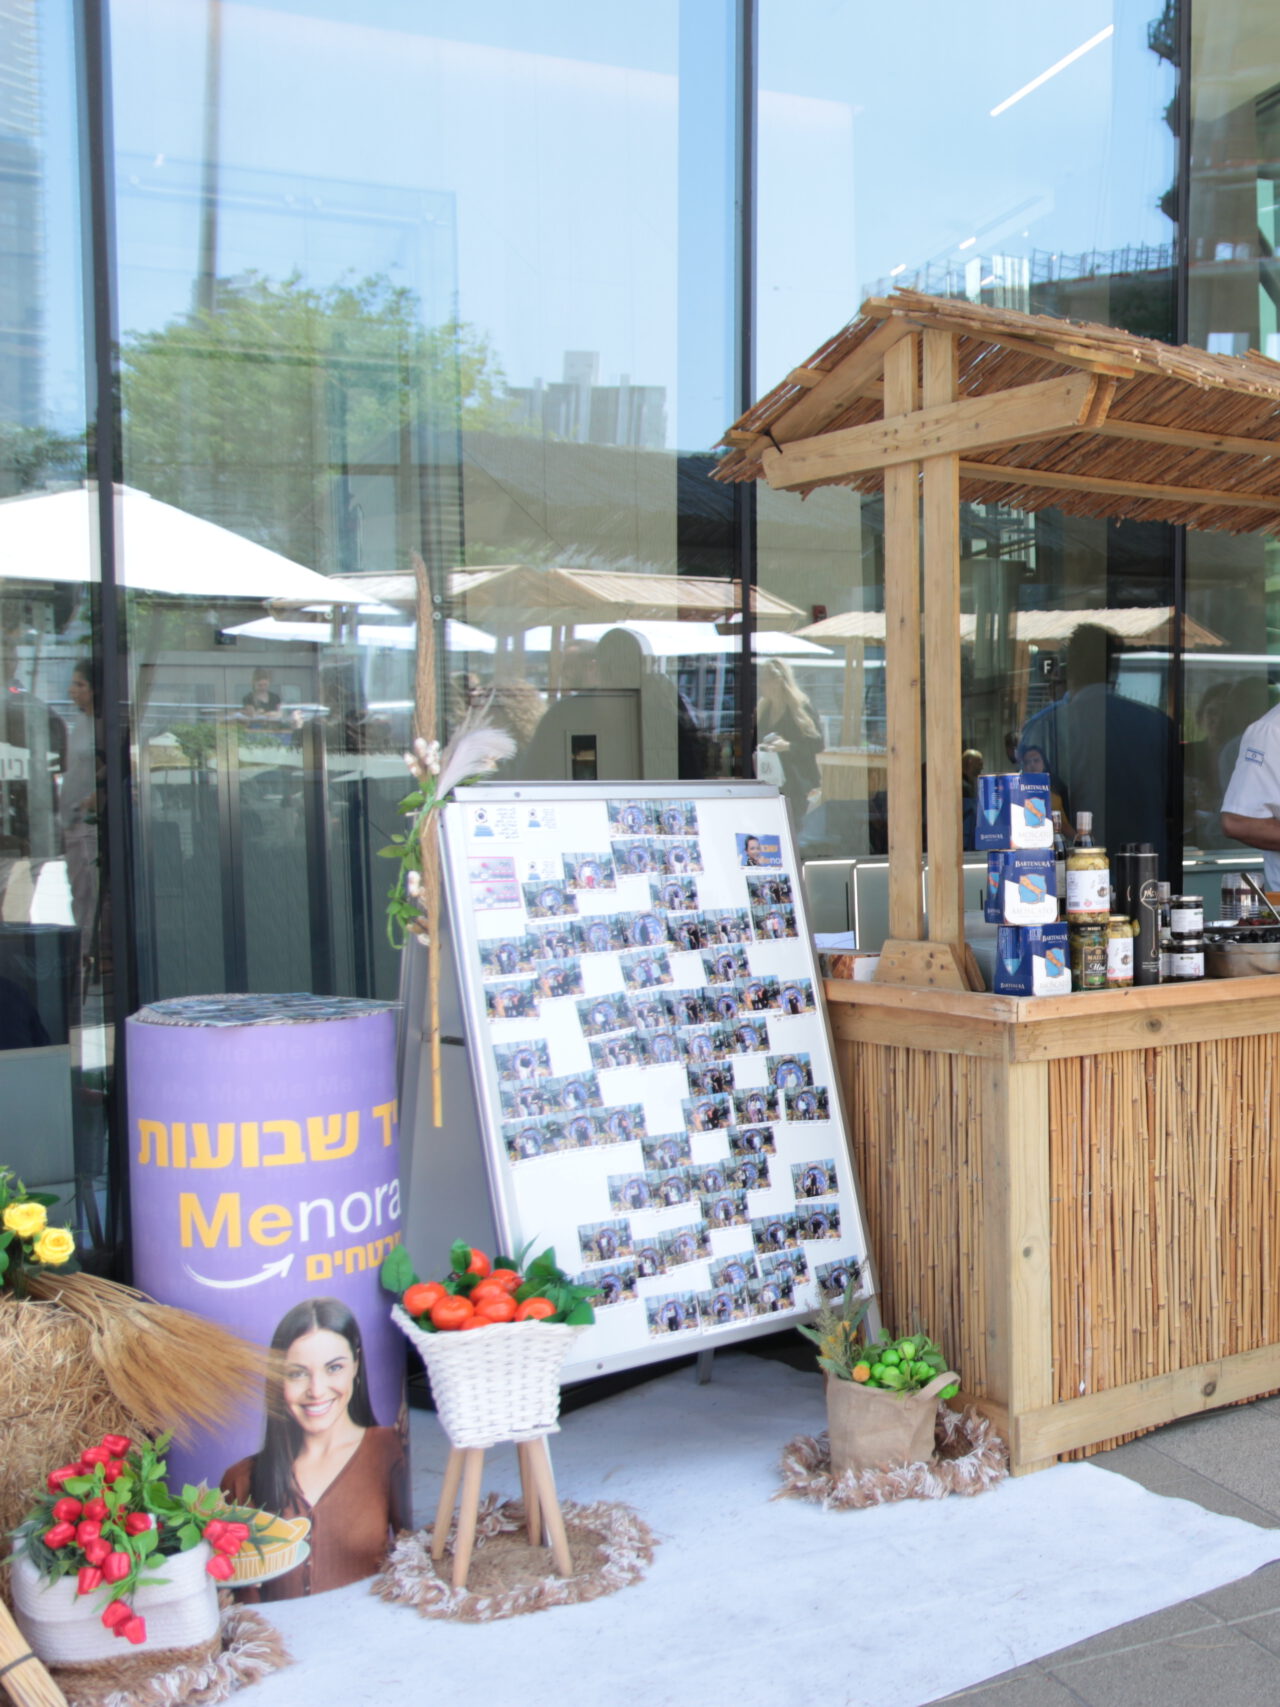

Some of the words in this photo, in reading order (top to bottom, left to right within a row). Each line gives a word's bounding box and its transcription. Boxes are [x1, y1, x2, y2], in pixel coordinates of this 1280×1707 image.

[1015, 860, 1051, 868] BARTENURA
[137, 1110, 360, 1169] שבועות
[179, 1177, 402, 1249] Menora
